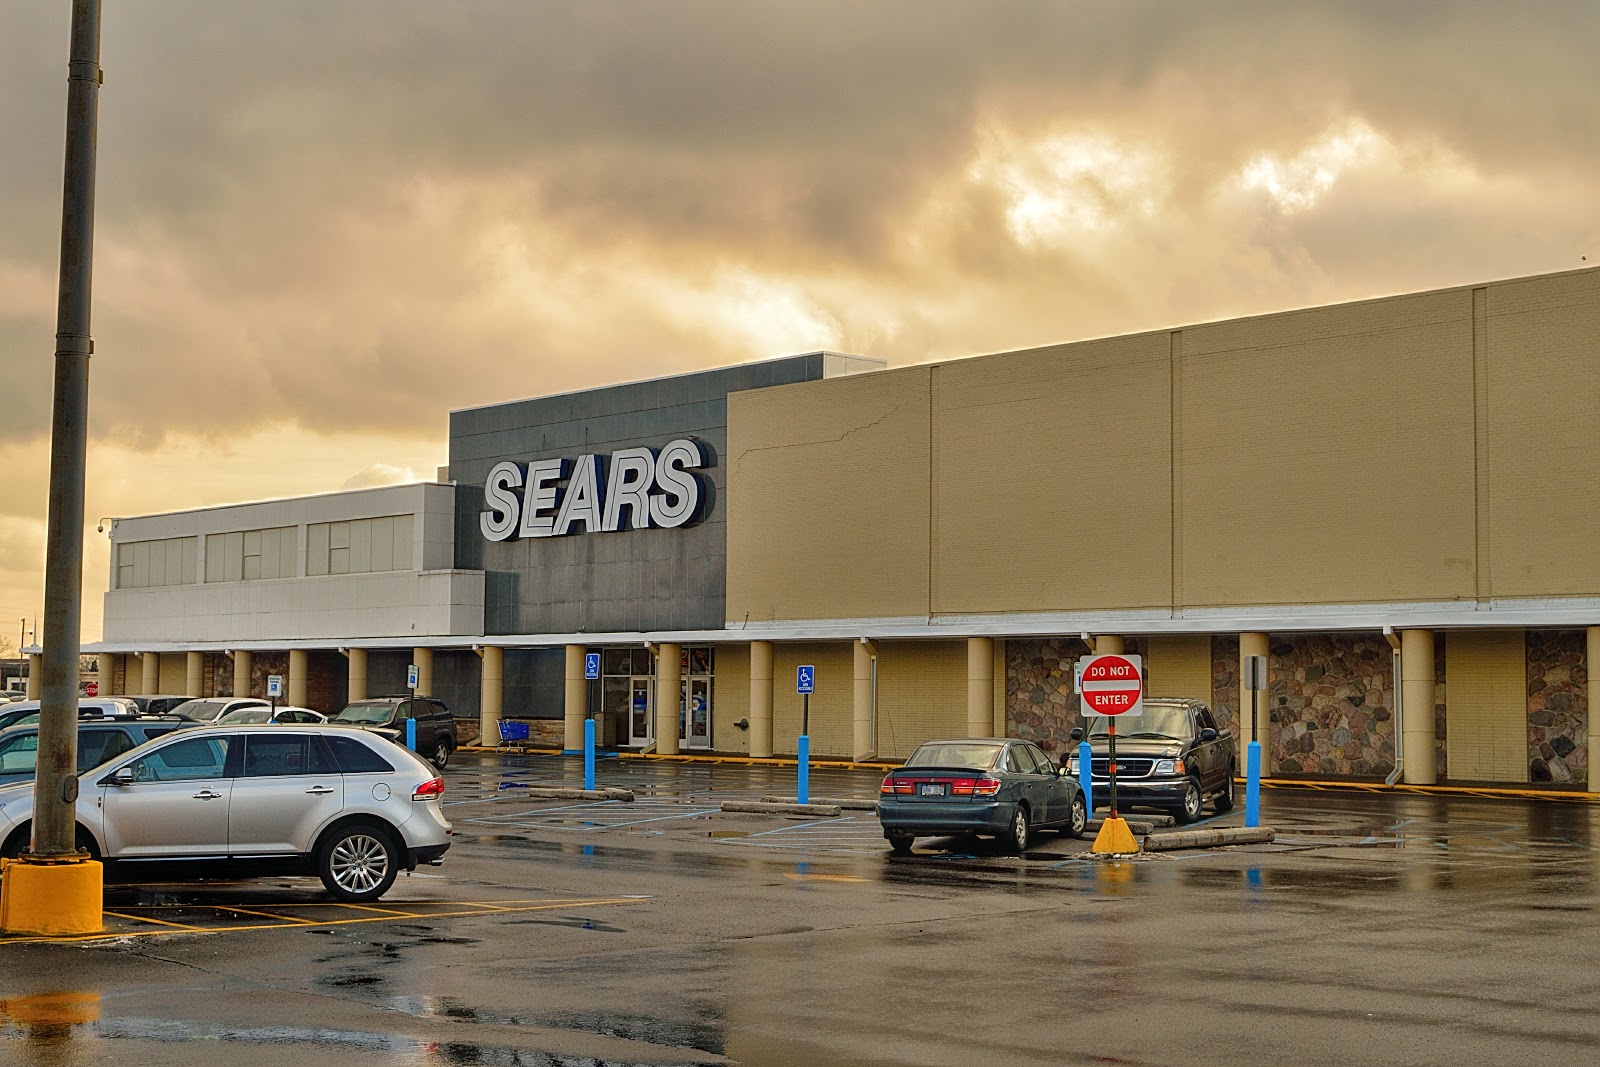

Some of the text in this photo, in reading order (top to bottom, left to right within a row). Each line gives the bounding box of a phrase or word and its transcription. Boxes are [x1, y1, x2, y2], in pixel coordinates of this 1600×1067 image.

[480, 438, 705, 542] SEARS
[1091, 667, 1106, 677] DO
[1109, 666, 1130, 676] NOT
[1095, 694, 1129, 705] ENTER
